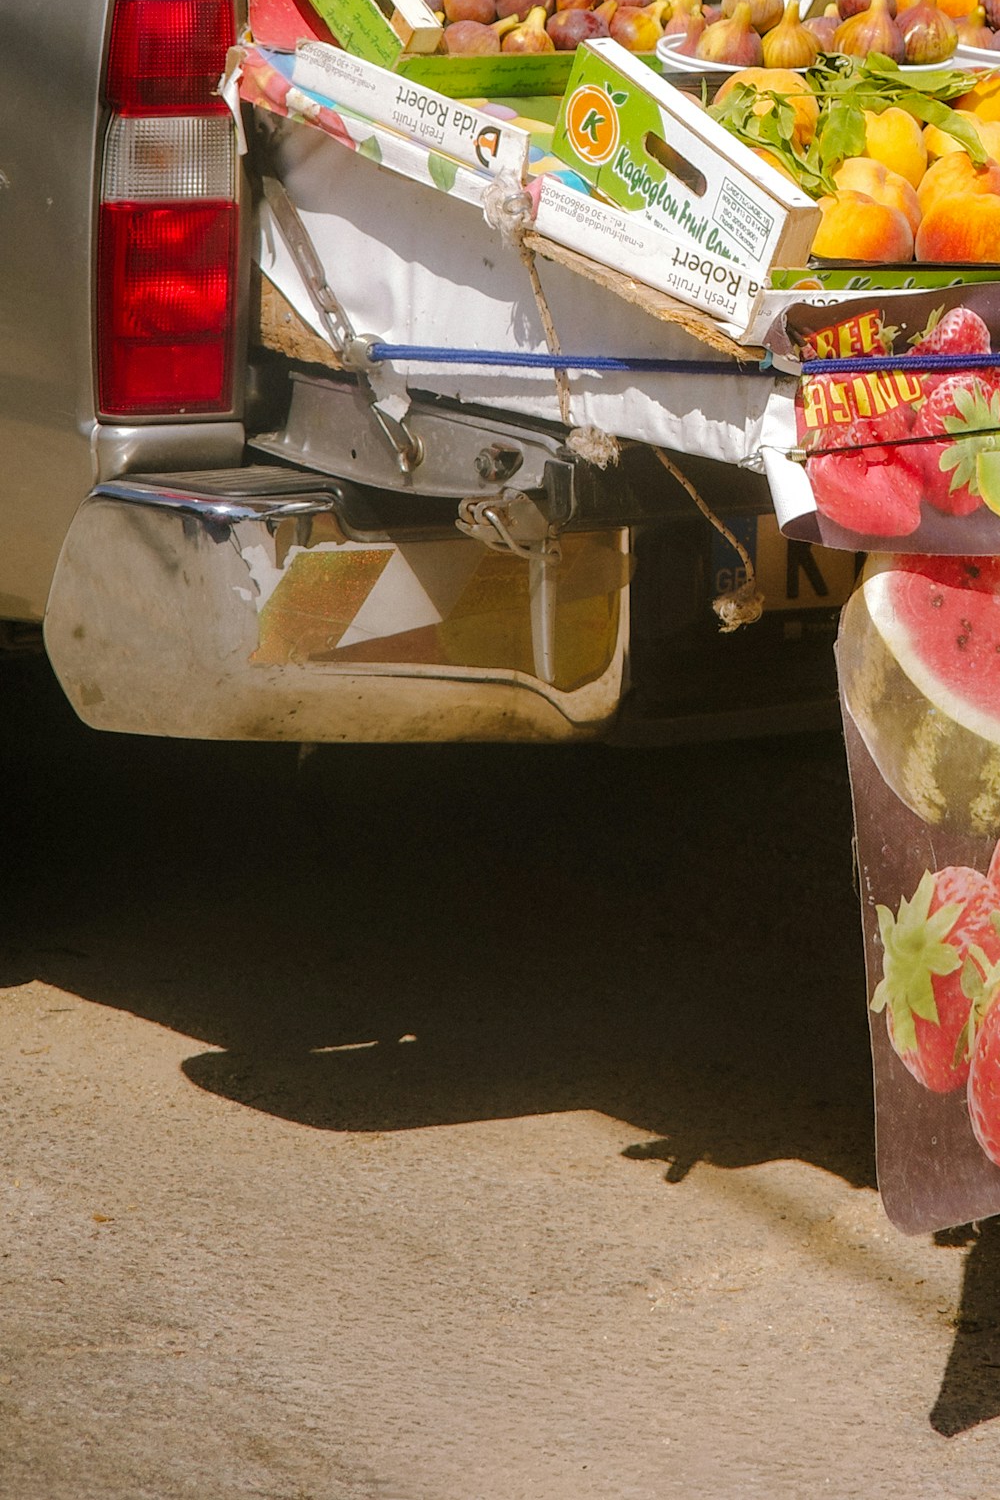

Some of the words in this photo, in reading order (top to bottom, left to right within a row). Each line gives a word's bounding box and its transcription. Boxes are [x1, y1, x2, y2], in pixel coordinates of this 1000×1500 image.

[392, 110, 418, 133] Fruits
[395, 85, 448, 127] Robert
[420, 123, 445, 145] Fresh
[580, 109, 606, 144] K
[614, 146, 679, 220] Kagioglou
[677, 200, 709, 245] Fruit
[591, 208, 607, 222] +30
[667, 272, 702, 299] Fruits
[672, 247, 742, 297] Robert
[703, 289, 737, 316] Fresh
[804, 311, 878, 359] REE
